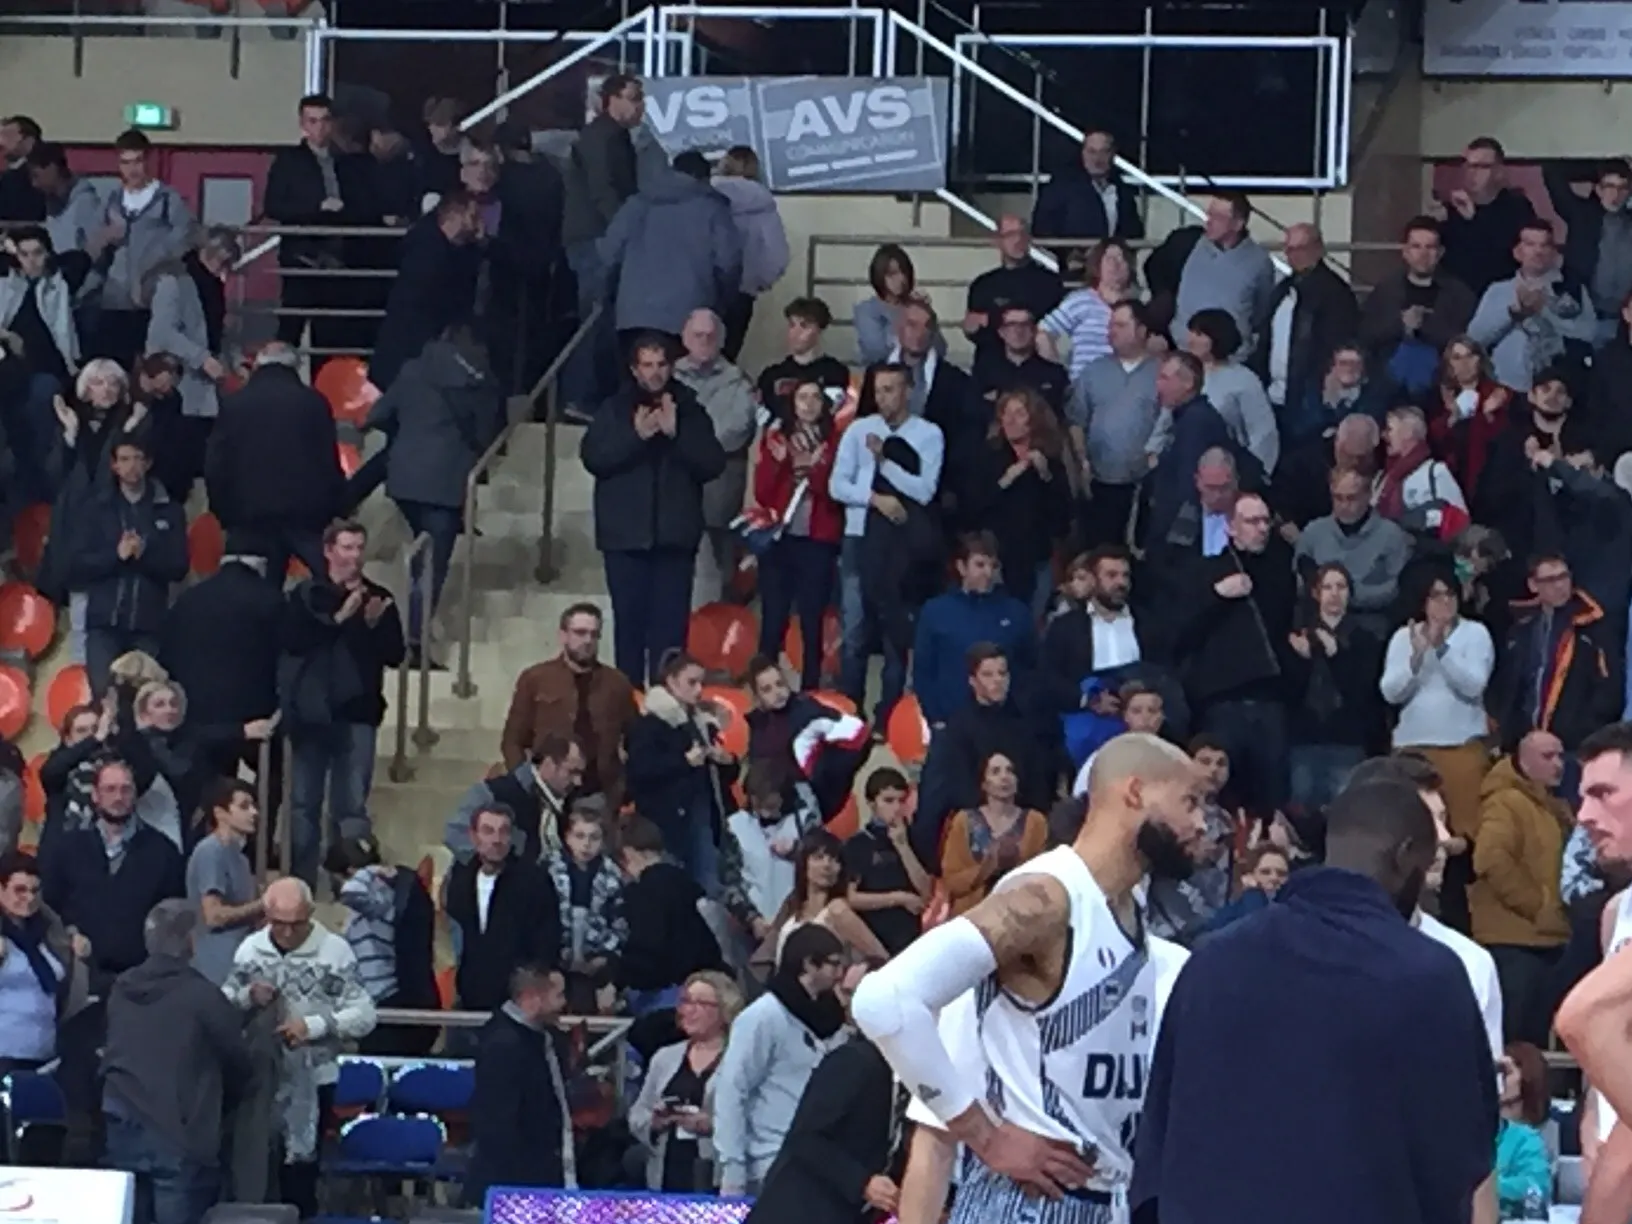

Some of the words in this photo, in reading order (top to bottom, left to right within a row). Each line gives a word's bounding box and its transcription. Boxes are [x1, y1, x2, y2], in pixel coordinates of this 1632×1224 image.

[642, 86, 728, 134] VS
[786, 86, 911, 141] AVS
[1082, 1053, 1148, 1100] DIJ
